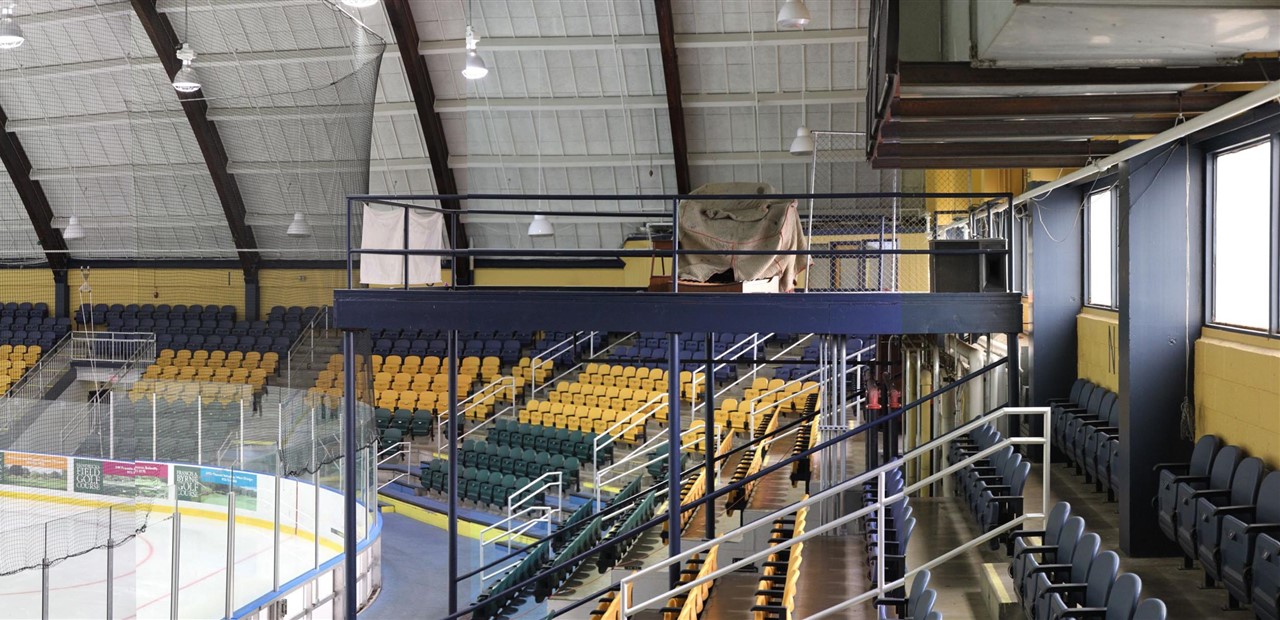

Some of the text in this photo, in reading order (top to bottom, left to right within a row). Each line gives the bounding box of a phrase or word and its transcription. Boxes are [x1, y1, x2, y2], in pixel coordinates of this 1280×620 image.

[1108, 325, 1116, 375] N
[77, 467, 101, 476] FIELD
[76, 474, 100, 484] GOLF
[76, 482, 100, 490] COURSE
[177, 481, 198, 491] GOLF
